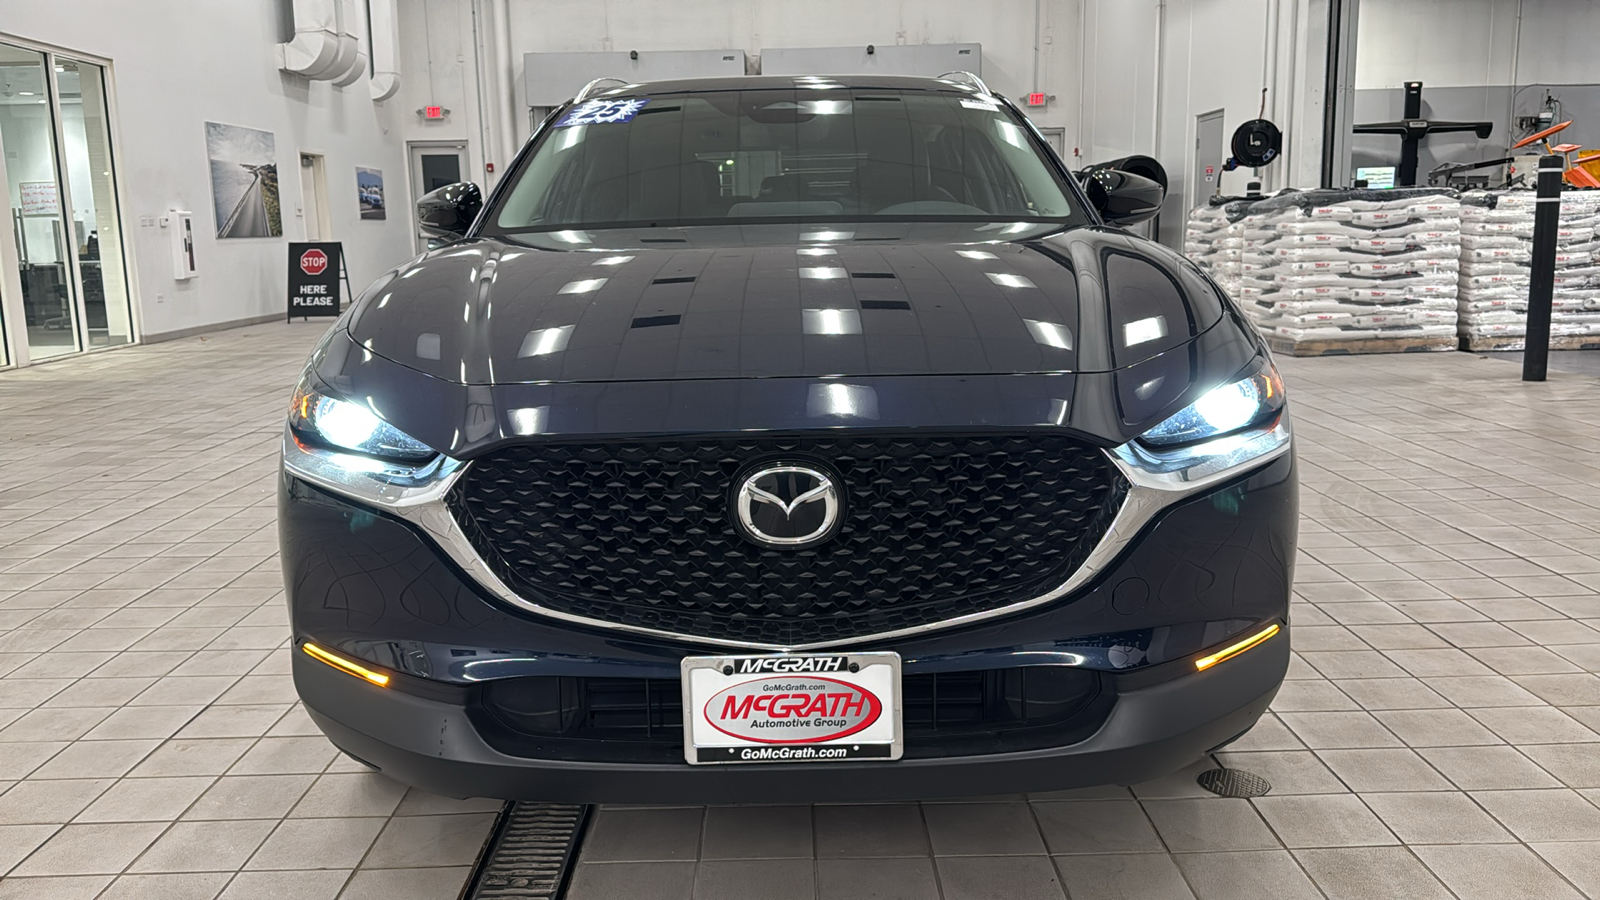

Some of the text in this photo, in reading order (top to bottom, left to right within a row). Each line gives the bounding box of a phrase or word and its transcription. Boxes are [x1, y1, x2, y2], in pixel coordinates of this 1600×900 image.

[303, 257, 326, 267] STOP
[300, 285, 327, 294] HERE
[293, 297, 333, 306] PLEASE
[762, 683, 826, 692] GoMcGrath.com
[750, 718, 847, 728] Automotive Group
[740, 747, 847, 760] GoMcGrath.com
